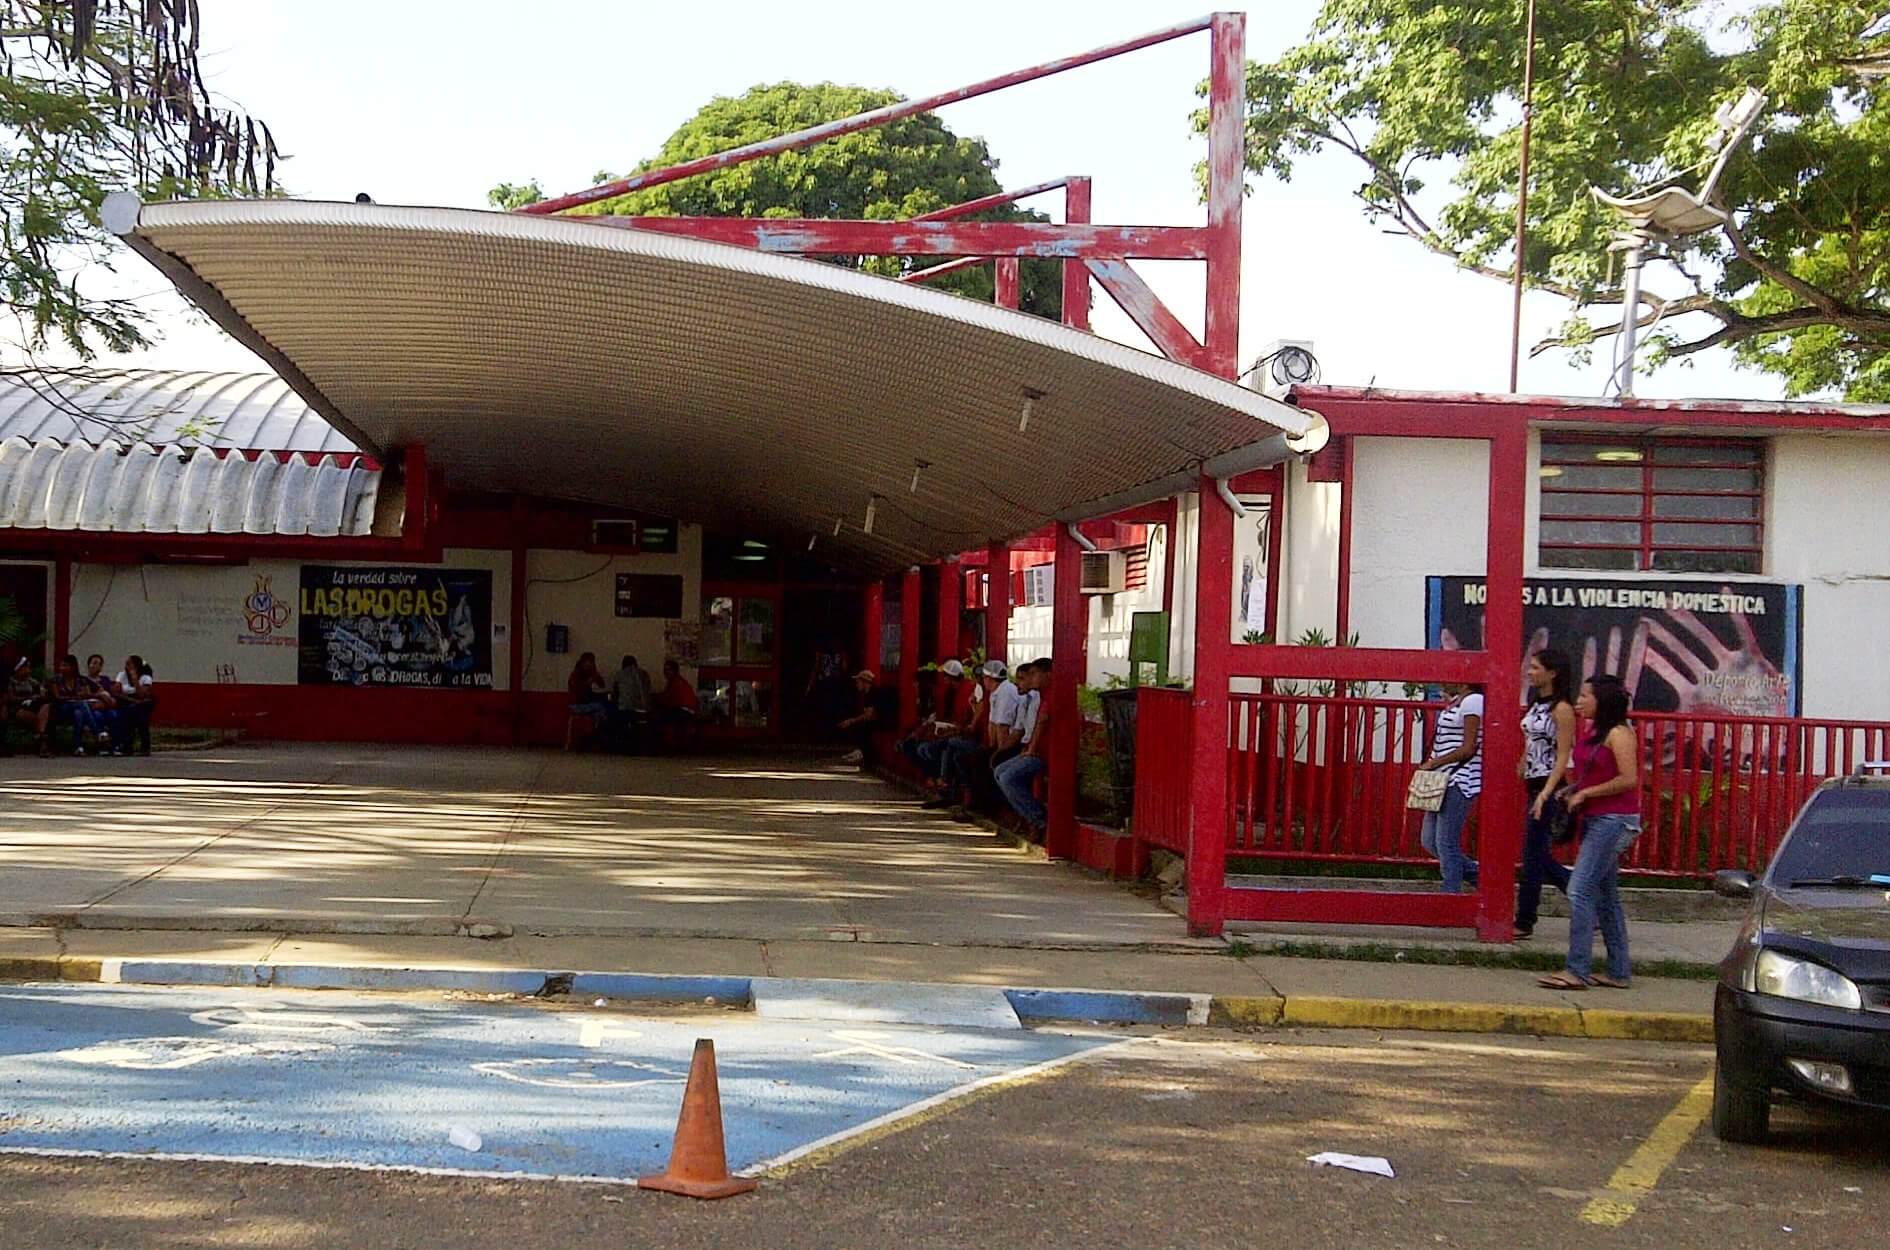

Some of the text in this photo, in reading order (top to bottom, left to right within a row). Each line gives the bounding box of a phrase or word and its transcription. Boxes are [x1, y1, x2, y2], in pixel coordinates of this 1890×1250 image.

[347, 571, 385, 585] verdad
[388, 572, 417, 585] sobre
[301, 587, 449, 617] LAS DROGAS
[1464, 584, 1488, 605] NO
[1536, 587, 1548, 605] A
[1552, 588, 1575, 606] LA
[1578, 588, 1667, 609] VIOLENCIA
[1672, 593, 1765, 615] DOMESTICA
